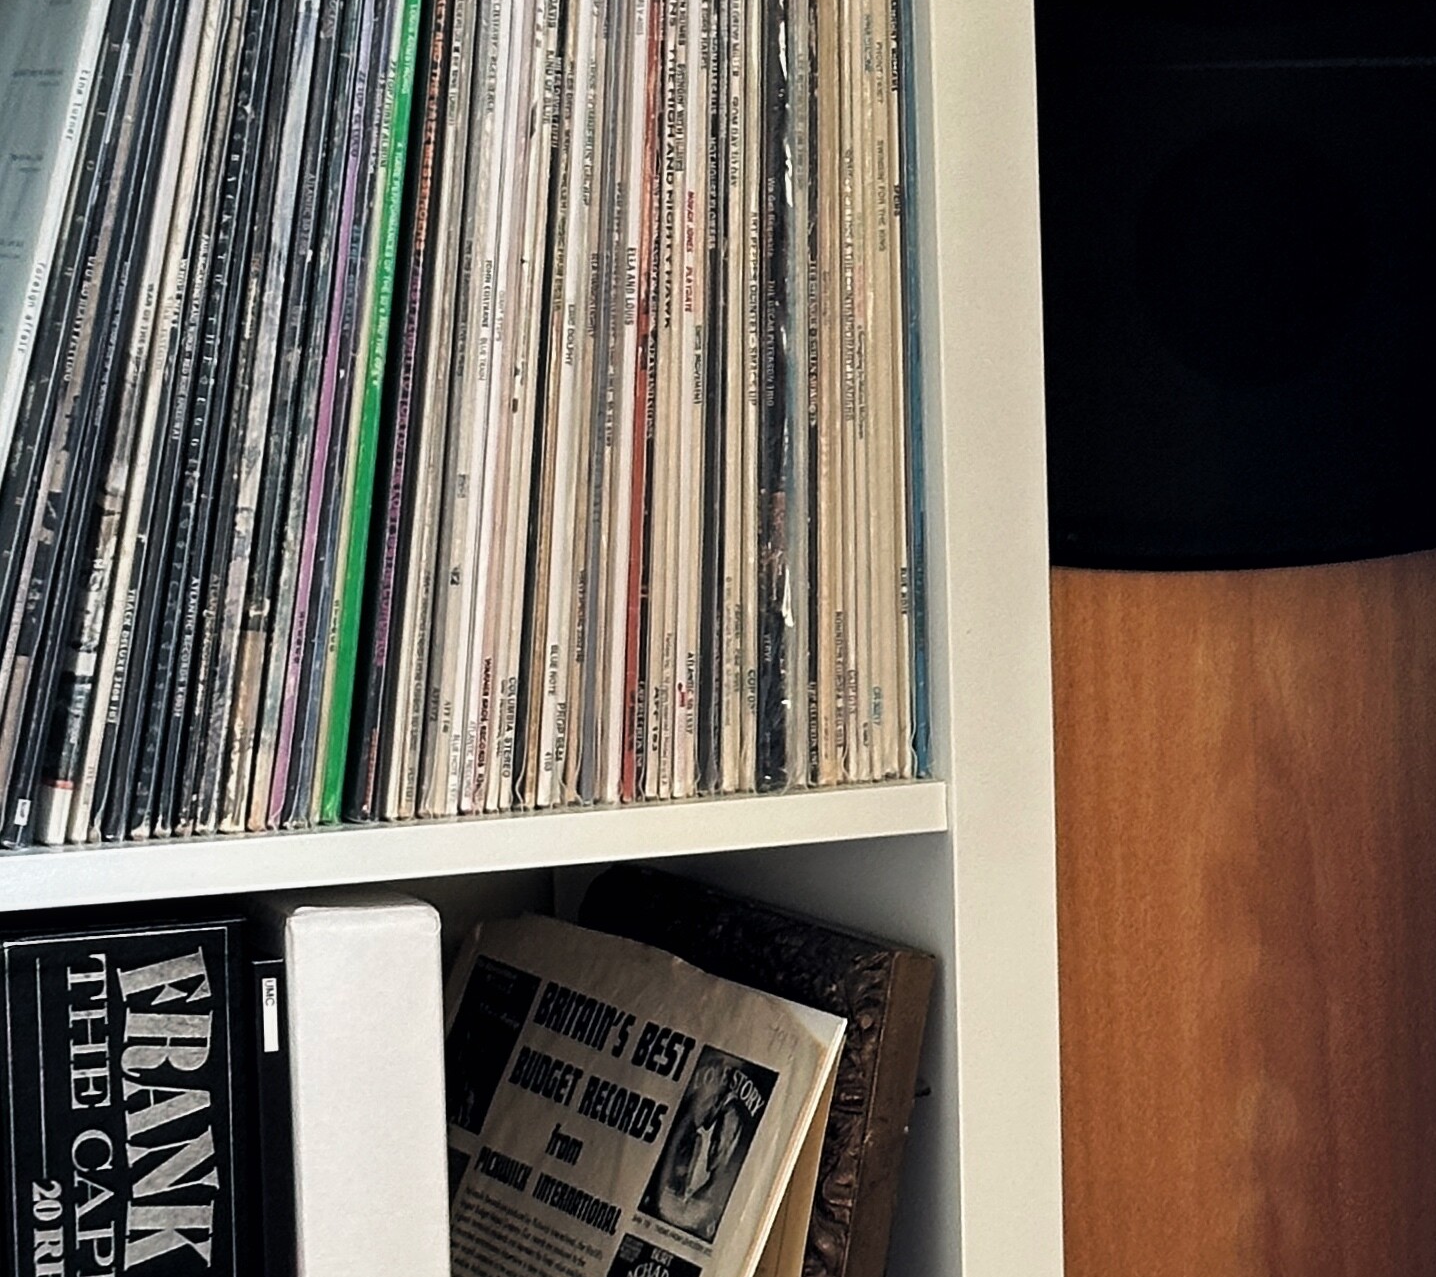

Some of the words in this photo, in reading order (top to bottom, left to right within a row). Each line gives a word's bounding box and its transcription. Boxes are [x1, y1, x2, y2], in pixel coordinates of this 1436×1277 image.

[504, 676, 517, 731] COLUMBIA
[501, 737, 513, 778] STEREO
[264, 978, 275, 1007] UMC
[67, 953, 111, 1109] THE
[533, 981, 636, 1058] BRITAIN'S
[631, 1020, 696, 1082] BEST
[117, 946, 220, 1271] FRANK
[508, 1045, 584, 1107] BUDGET
[577, 1074, 669, 1144] RECORDS
[729, 1069, 766, 1118] STORY
[545, 1122, 584, 1167] from
[32, 1180, 63, 1222] 20
[473, 1144, 533, 1193] PICKWICK
[531, 1171, 622, 1237] INTERNATIONAL
[651, 1247, 674, 1267] BURT
